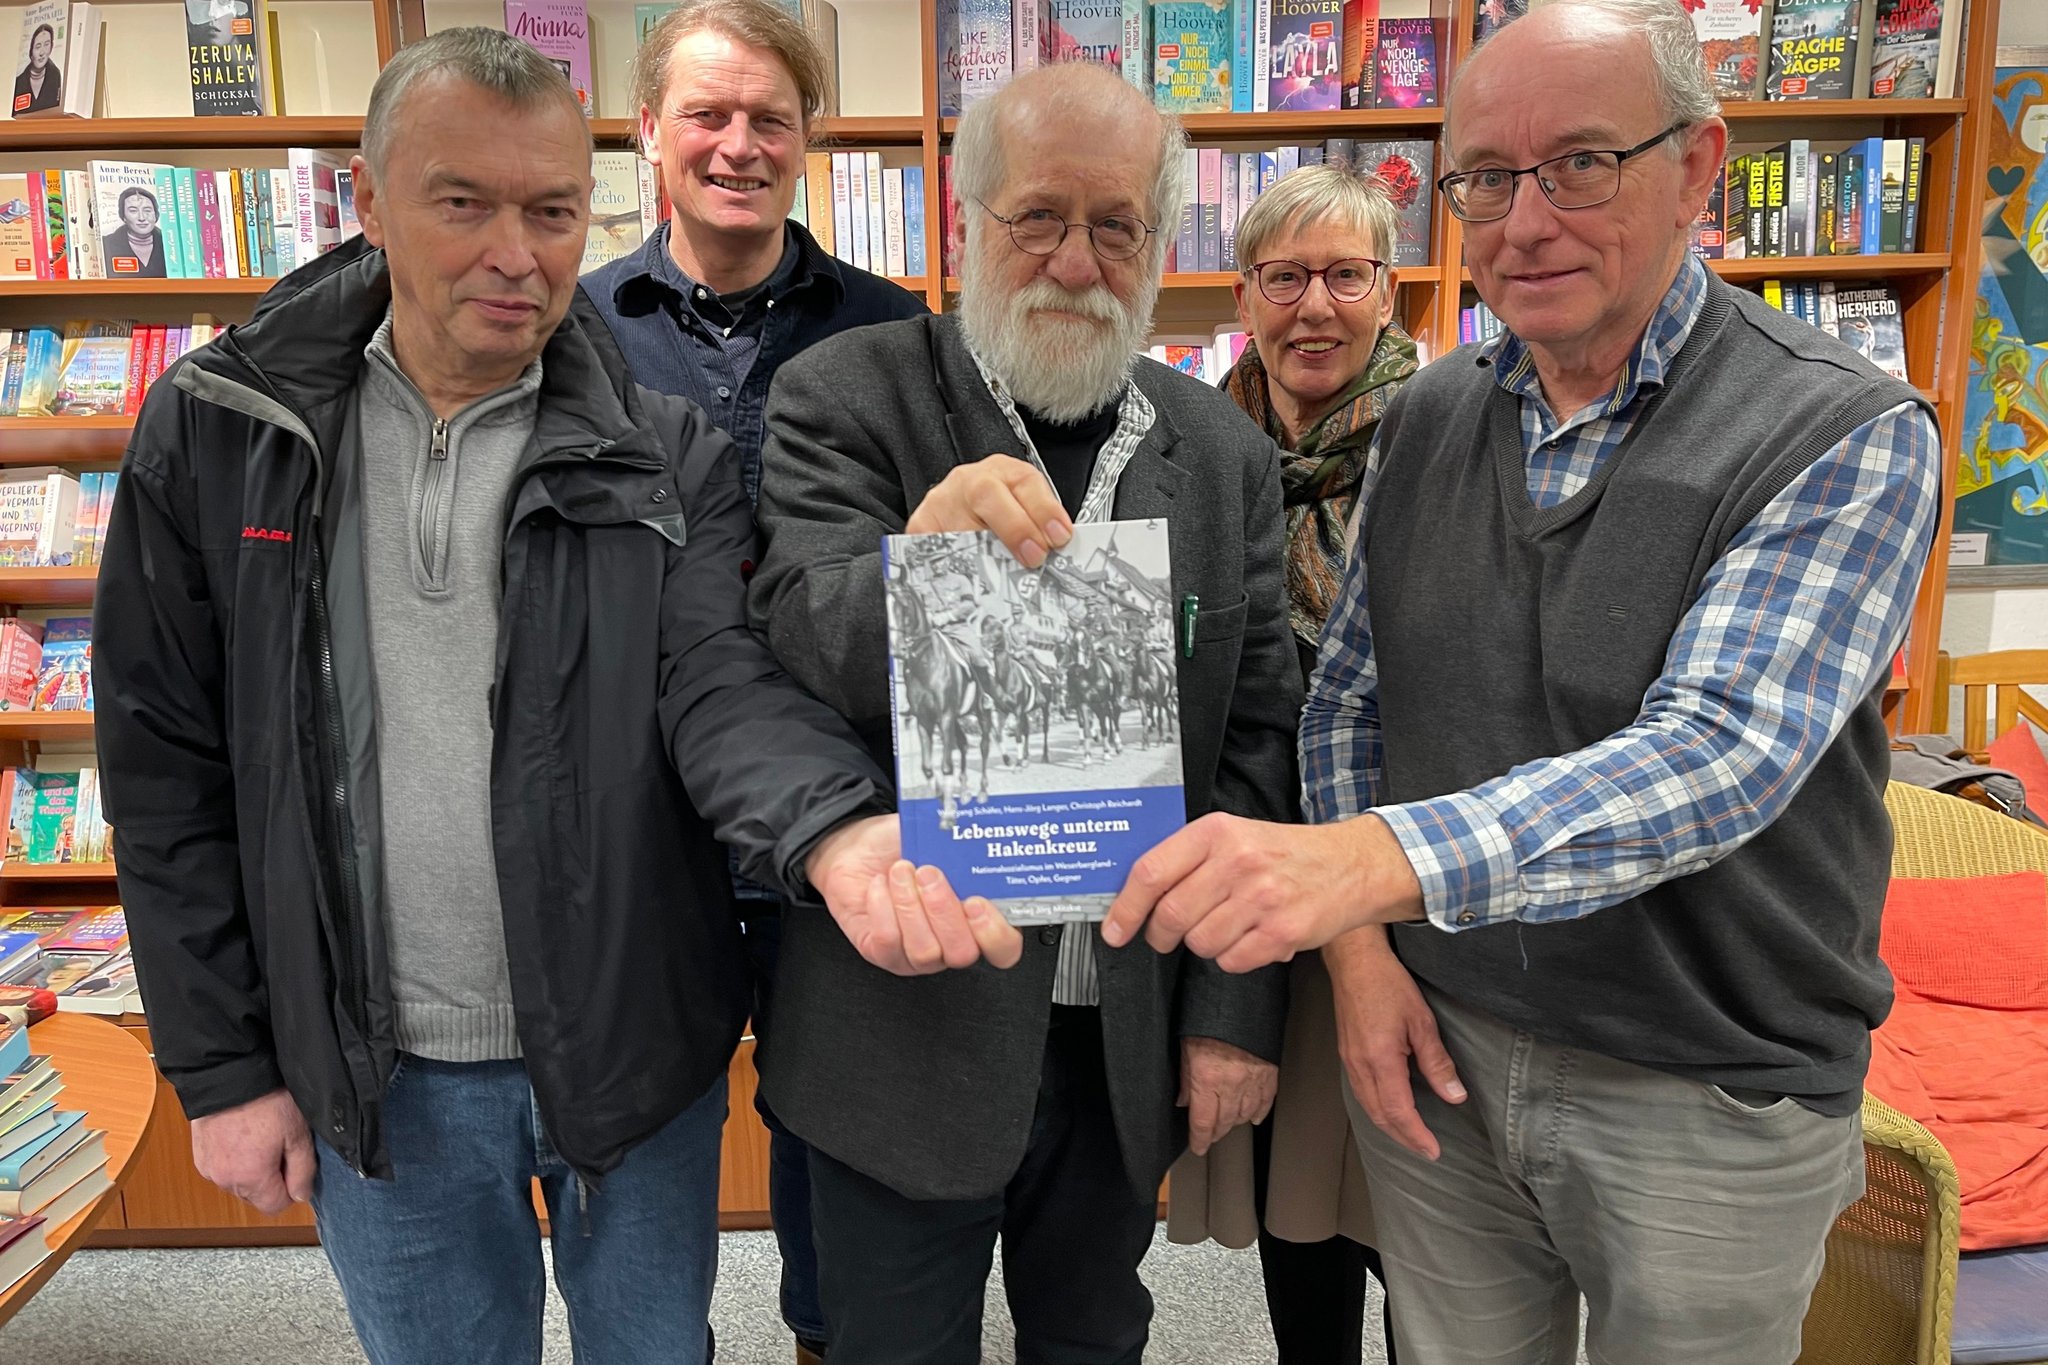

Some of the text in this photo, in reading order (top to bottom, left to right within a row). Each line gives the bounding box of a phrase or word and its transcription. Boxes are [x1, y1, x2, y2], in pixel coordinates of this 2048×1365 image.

[1056, 1, 1122, 19] HOOVER
[1273, 0, 1341, 17] HOOVER
[514, 11, 586, 40] Minna
[1164, 12, 1225, 30] HOOVER
[1878, 6, 1939, 37] LÖHNIG
[960, 31, 987, 46] LIKE
[1180, 33, 1199, 45] NUR
[1366, 18, 1374, 54] TOO LATE
[1382, 39, 1399, 49] NUR
[1886, 32, 1927, 45] Der Spieler
[190, 43, 254, 64] ZERUYA
[1185, 46, 1209, 58] NOCH
[1387, 47, 1416, 60] NOCH
[1781, 36, 1846, 56] RACHE
[943, 45, 1007, 73] feathers
[1179, 59, 1211, 72] EINMAL
[1258, 48, 1267, 81] HOOVER
[1271, 40, 1339, 79] LAYLA
[1381, 58, 1426, 74] WENIGE
[1781, 54, 1841, 75] JÄGER
[192, 64, 256, 85] SHALEV
[952, 67, 999, 82] WE FLY
[1171, 71, 1207, 85] UND FÜR
[1363, 60, 1373, 93] HOOVER
[1390, 73, 1420, 87] TAGE
[195, 89, 257, 100] SCHICKSAL
[1171, 85, 1201, 98] IMMER
[99, 165, 150, 175] Anne Berest
[99, 175, 115, 183] DIE
[596, 178, 610, 189] as
[1749, 161, 1764, 208] FINSTER
[1768, 160, 1783, 207] FINSTER
[592, 189, 626, 204] Echo
[641, 179, 651, 220] RING FIRE
[1843, 174, 1852, 215] MORTON
[246, 192, 256, 227] Der Zopf
[296, 165, 313, 243] SPRUNG INS LEERE
[1753, 212, 1761, 246] MENGER
[1771, 211, 1779, 245] MENGER
[1842, 216, 1850, 240] KATE
[912, 233, 921, 263] SCOTT
[1784, 287, 1795, 314] FOREST
[1804, 287, 1814, 314] FOREST
[1837, 288, 1888, 304] CATHERINE
[1838, 299, 1897, 319] HEPHERD
[69, 327, 95, 337] Dora
[150, 337, 160, 366] SISTERS
[85, 362, 119, 372] Johanne
[129, 337, 143, 397] SEASON SISTERS
[6, 497, 46, 507] VERMALT
[2, 511, 20, 520] UND
[14, 641, 27, 649] auf
[13, 650, 28, 659] dem
[936, 808, 973, 818] Wgang
[973, 806, 1003, 816] Schäfer,
[1069, 800, 1107, 811] Christoph
[1107, 798, 1143, 809] Reichardt
[952, 819, 1131, 840] Lebenswege unterm
[986, 840, 1098, 858] Hakenkreuz
[1044, 862, 1054, 870] im
[1054, 859, 1111, 871] Weserbergland
[1027, 874, 1053, 885] Opfer,
[1053, 873, 1082, 884] Gegner
[1010, 906, 1034, 916] Verlag
[1035, 905, 1052, 915] Jörg
